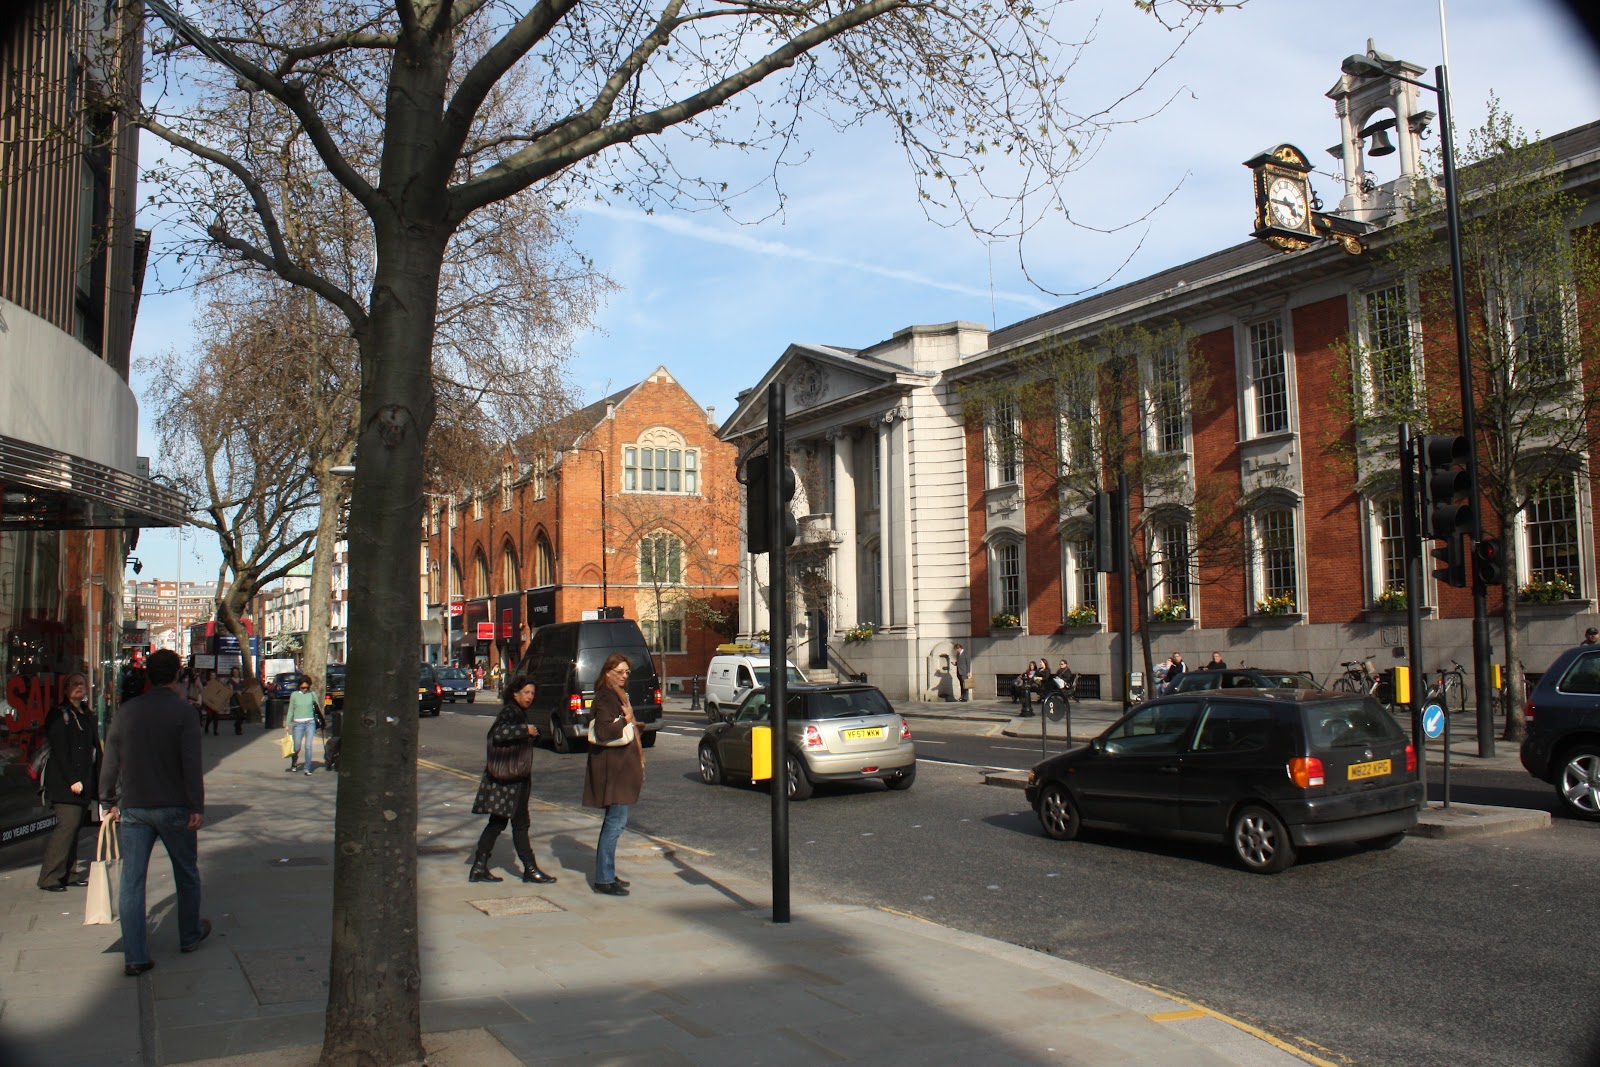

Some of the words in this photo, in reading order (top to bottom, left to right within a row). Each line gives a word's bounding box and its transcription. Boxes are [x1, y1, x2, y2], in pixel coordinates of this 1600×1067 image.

[3, 830, 13, 841] 200
[13, 824, 30, 837] YEARS
[30, 822, 37, 832] OF
[37, 817, 53, 830] DESIGN
